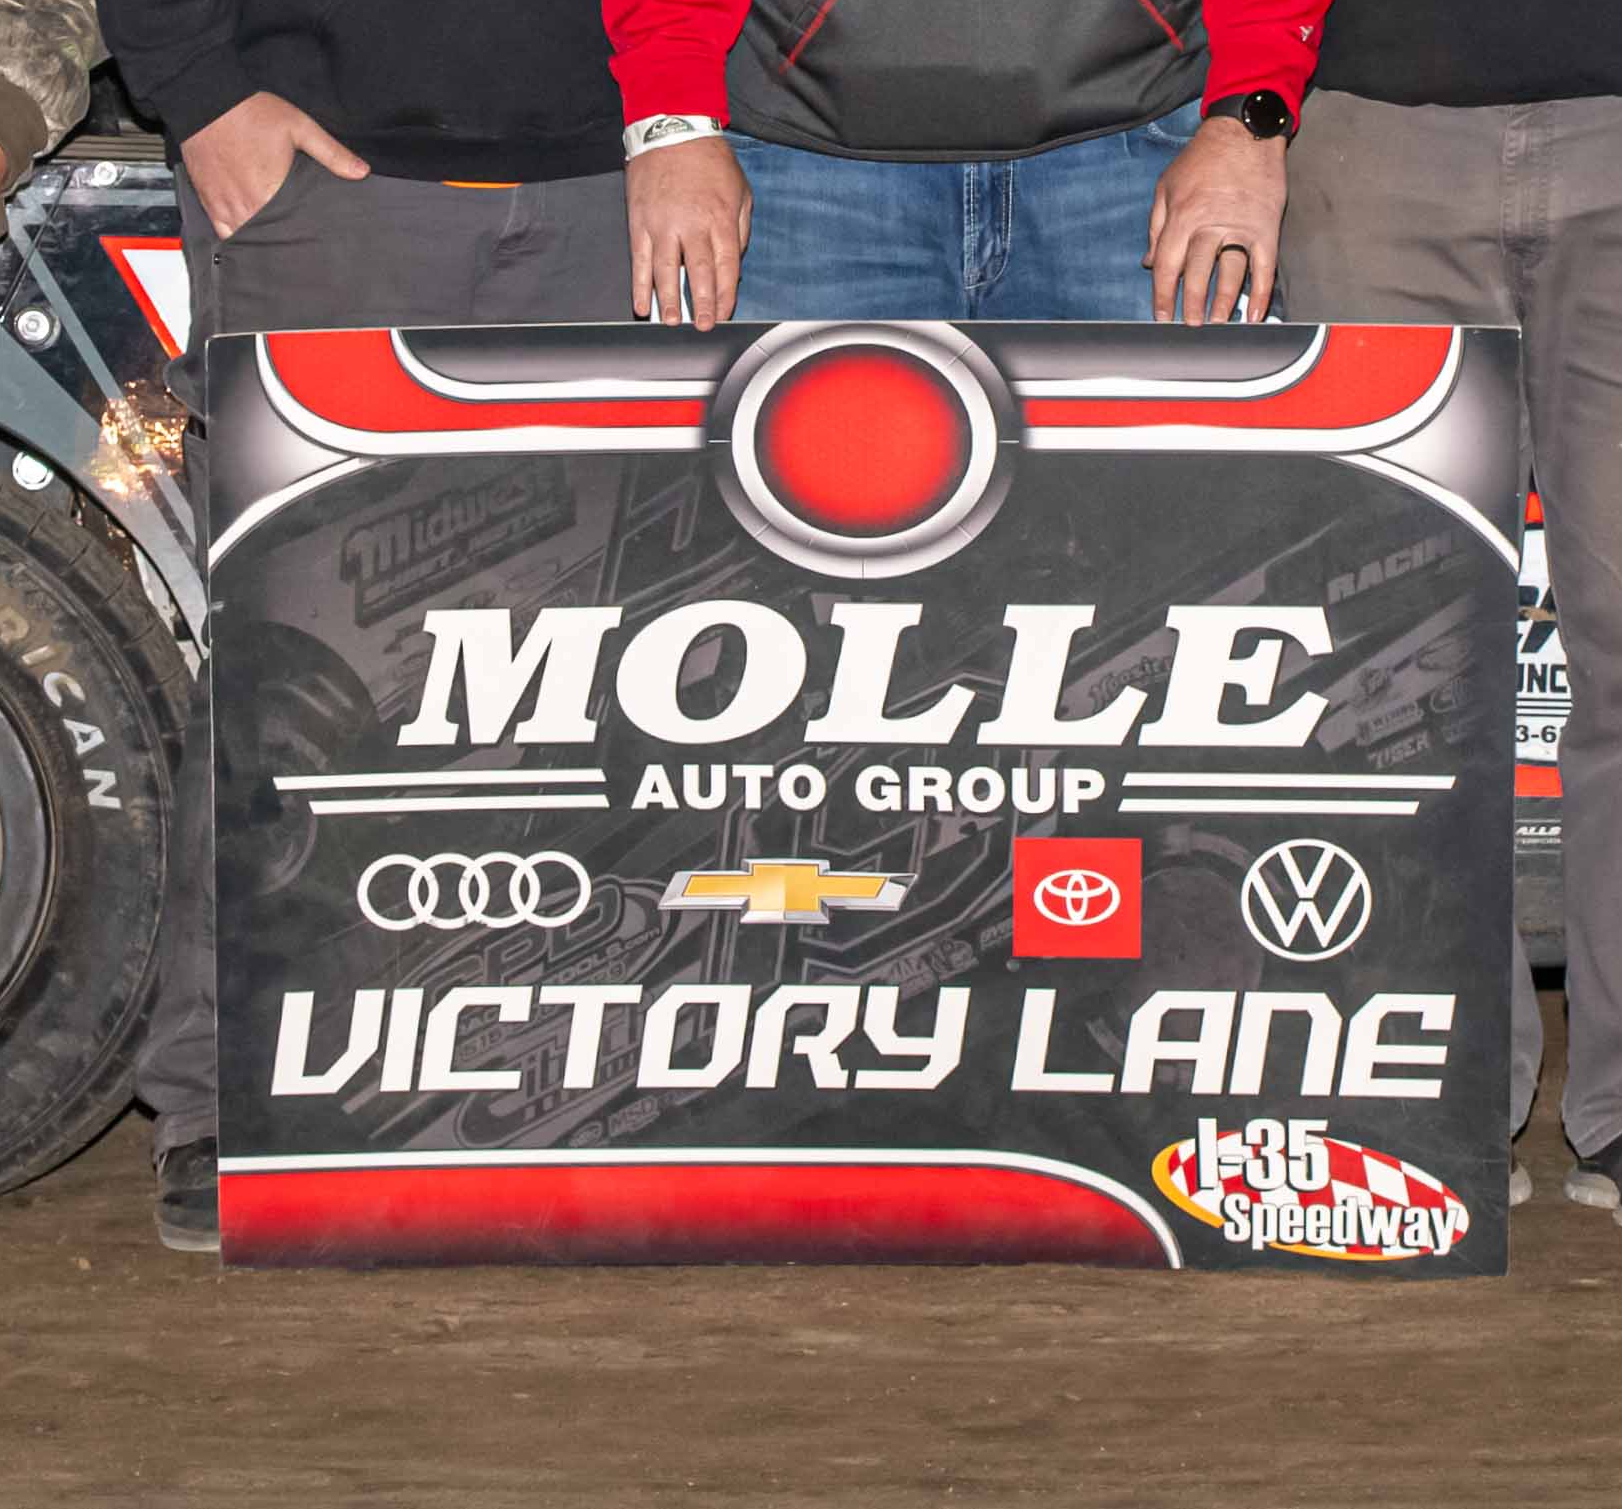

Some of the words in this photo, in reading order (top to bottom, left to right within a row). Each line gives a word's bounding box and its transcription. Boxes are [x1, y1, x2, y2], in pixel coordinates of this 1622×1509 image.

[396, 599, 1334, 747] MOLLE
[631, 763, 827, 812] AUTO
[855, 764, 1107, 814] GROUP
[270, 984, 971, 1096] VICTORY
[1011, 987, 1456, 1098] LANE
[1196, 1117, 1330, 1191] I-35
[1223, 1193, 1460, 1256] Speedway
